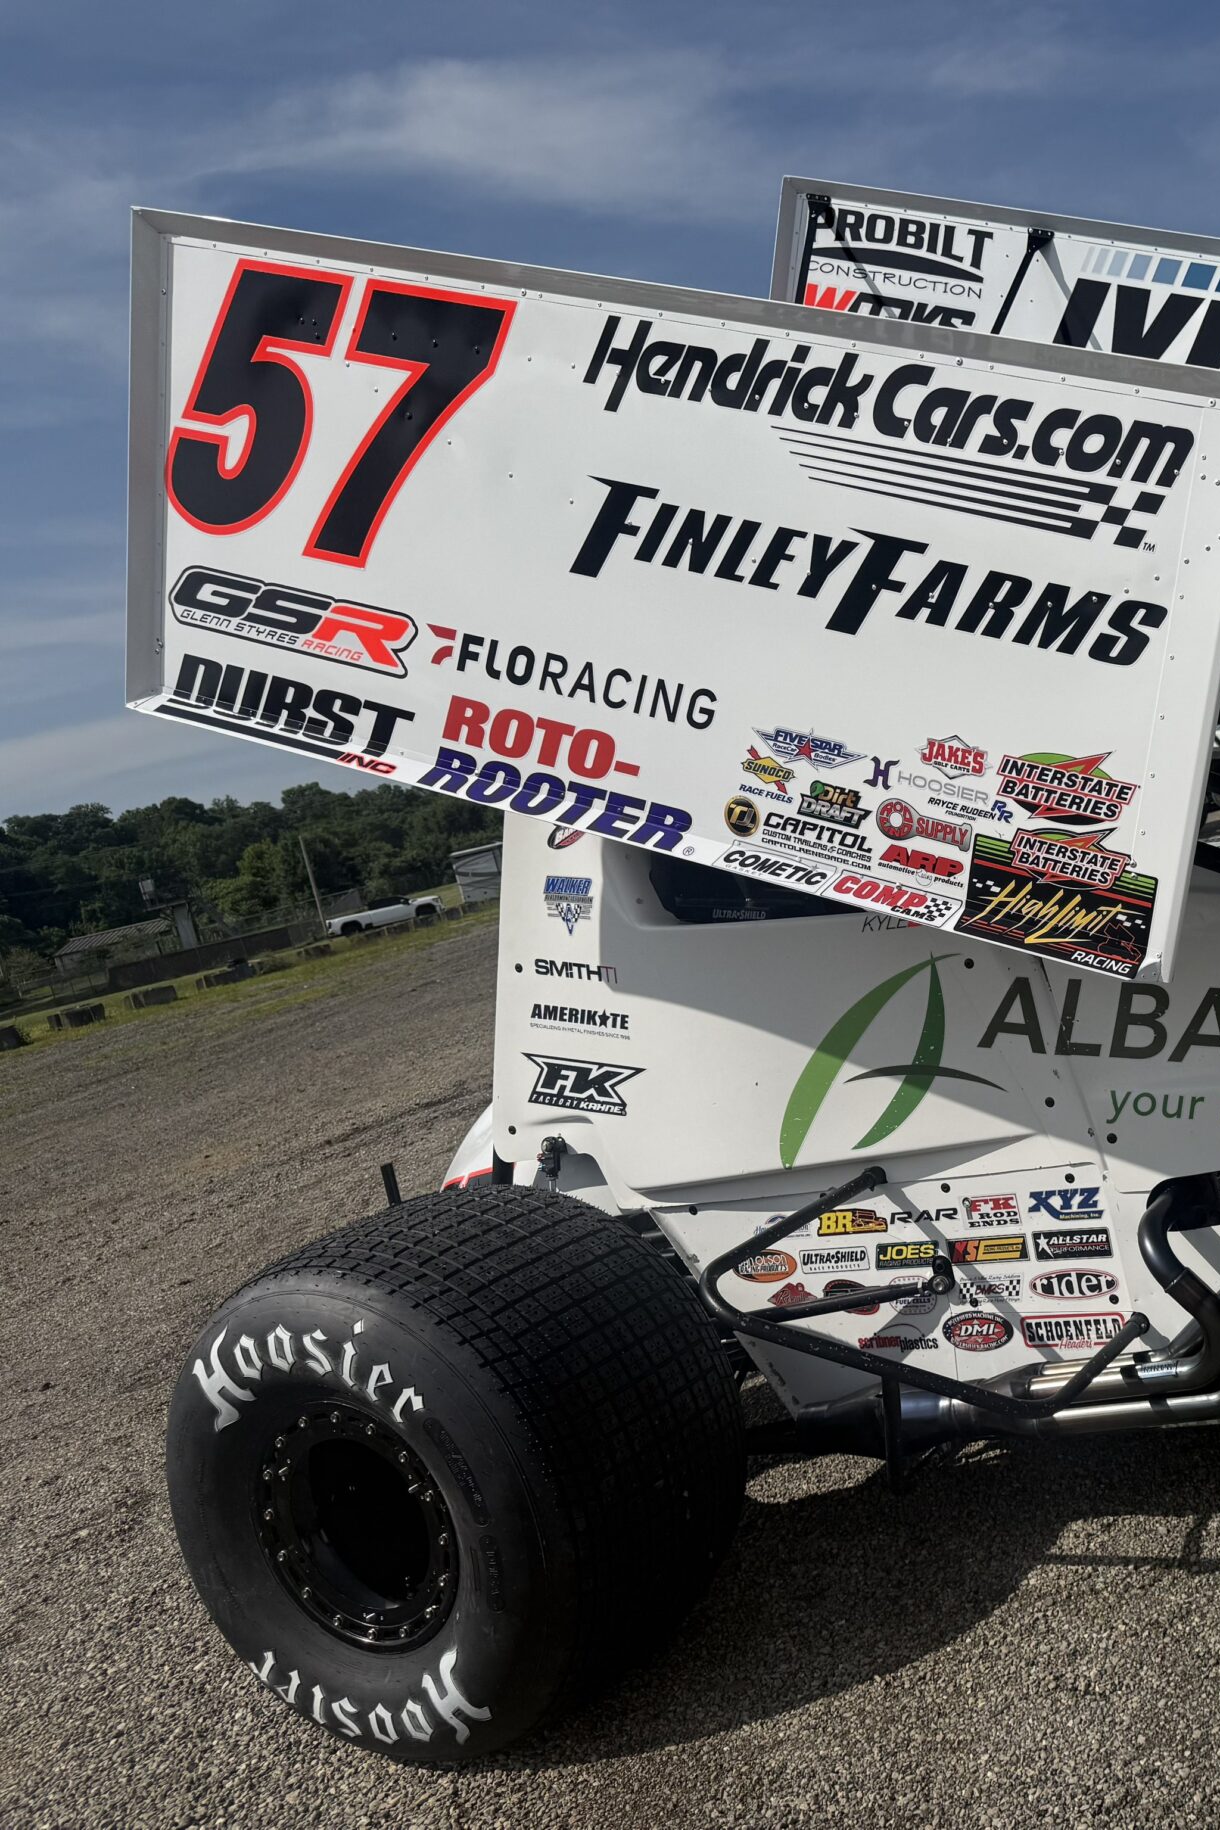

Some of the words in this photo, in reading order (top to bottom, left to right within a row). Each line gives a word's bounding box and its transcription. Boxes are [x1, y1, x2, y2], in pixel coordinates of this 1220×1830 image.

[808, 260, 982, 299] CONSTRUCTION
[164, 257, 518, 569] 57
[569, 475, 860, 599] FINLEY
[824, 526, 1168, 667] FARMS
[173, 571, 410, 668] GSR
[180, 608, 231, 628] GLENN
[234, 622, 300, 646] STYRES
[300, 638, 364, 662] RACING
[166, 653, 416, 758] DURST
[442, 694, 641, 780] ROTO-
[774, 729, 809, 746] FIVE
[810, 738, 844, 756] STAR
[338, 753, 397, 774] INC
[745, 761, 792, 781] SUNOCO
[921, 740, 985, 777] JAKE'S
[933, 760, 949, 768] GOLF
[949, 764, 971, 773] CARTS
[897, 770, 989, 805] HOOSIER
[1001, 758, 1132, 802] INTERSTATE
[416, 745, 693, 852] ROOTER
[739, 784, 765, 797] RACE
[765, 790, 794, 804] FUELS
[819, 785, 857, 806] Dirt
[1001, 779, 1120, 819] BATTERIES
[801, 797, 865, 824] DRAFT
[928, 797, 959, 811] RAYCE
[959, 804, 997, 820] RUDEEN
[763, 811, 873, 854] CAPITOL
[916, 817, 969, 846] SUPPLY
[762, 829, 791, 842] CUSTOM
[793, 836, 828, 851] TRAILERS
[837, 847, 872, 862] COACHES
[1016, 835, 1121, 872] INTERSTATE
[723, 850, 828, 886] COMETIC
[877, 861, 915, 876] automotive
[933, 875, 964, 888] products
[880, 844, 965, 878] ARP
[1017, 853, 1112, 886] BATTERIES
[832, 875, 929, 910] COMP
[890, 905, 938, 922] CAMS
[1071, 950, 1133, 974] RACING
[532, 1094, 578, 1108] FACTORY
[579, 1101, 624, 1114] KAHNE
[1106, 1089, 1206, 1125] your
[970, 1196, 1017, 1213] FK
[1028, 1187, 1101, 1214] XYZ
[968, 1218, 1020, 1228] ENDS
[977, 1211, 1018, 1220] ROD
[879, 1244, 935, 1261] JOES
[1049, 1234, 1107, 1245] ALLSTAR
[1049, 1244, 1110, 1254] PERFORMANCE
[879, 1259, 901, 1267] RACING
[1034, 1271, 1114, 1298] rider
[959, 1323, 996, 1337] DMI
[1025, 1318, 1123, 1343] SCHOENFELD
[1058, 1338, 1094, 1350] Headers
[191, 1317, 425, 1432] Hoosier
[247, 1644, 494, 1746] Hoosier
